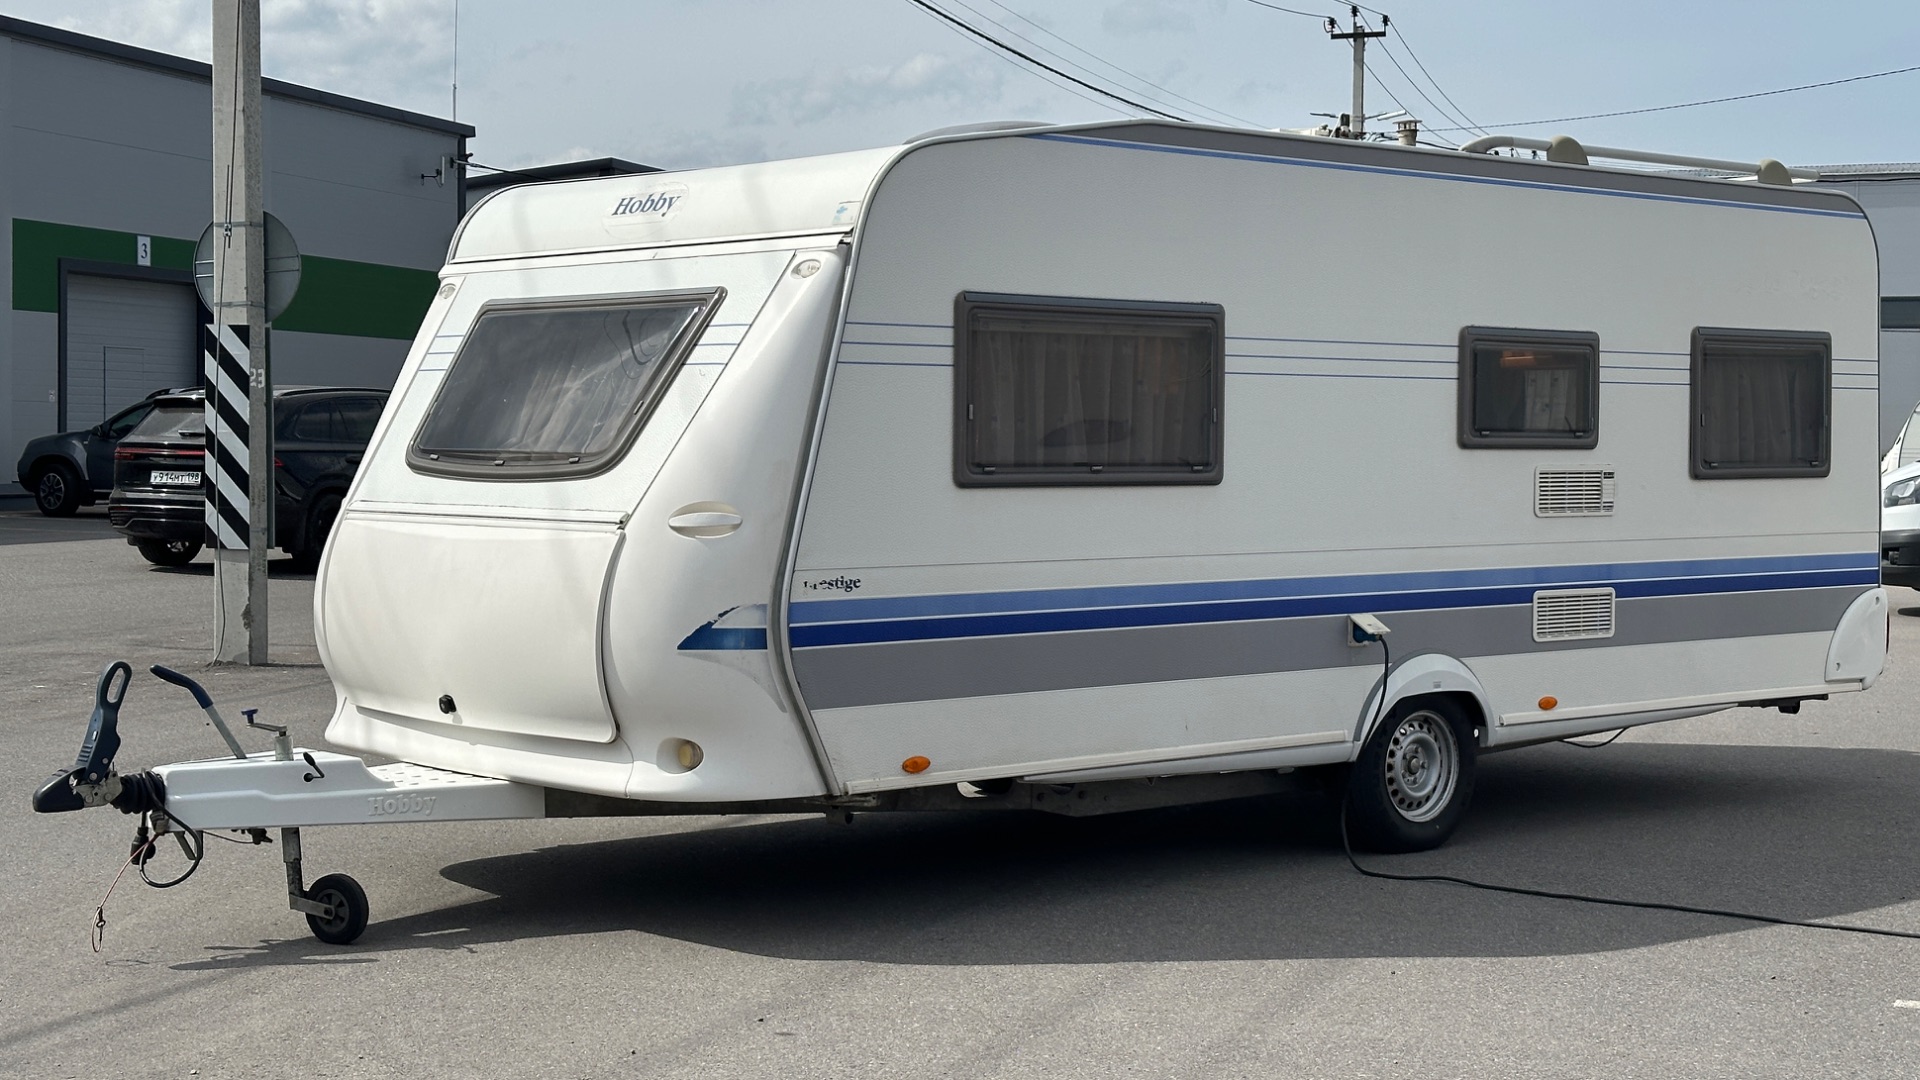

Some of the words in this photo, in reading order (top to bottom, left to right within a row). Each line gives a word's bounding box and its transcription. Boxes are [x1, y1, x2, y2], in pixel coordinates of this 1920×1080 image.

[611, 191, 682, 217] Hobby
[140, 242, 148, 259] 3
[250, 368, 265, 388] 23
[803, 576, 861, 592] estige
[367, 793, 437, 817] Hobby
